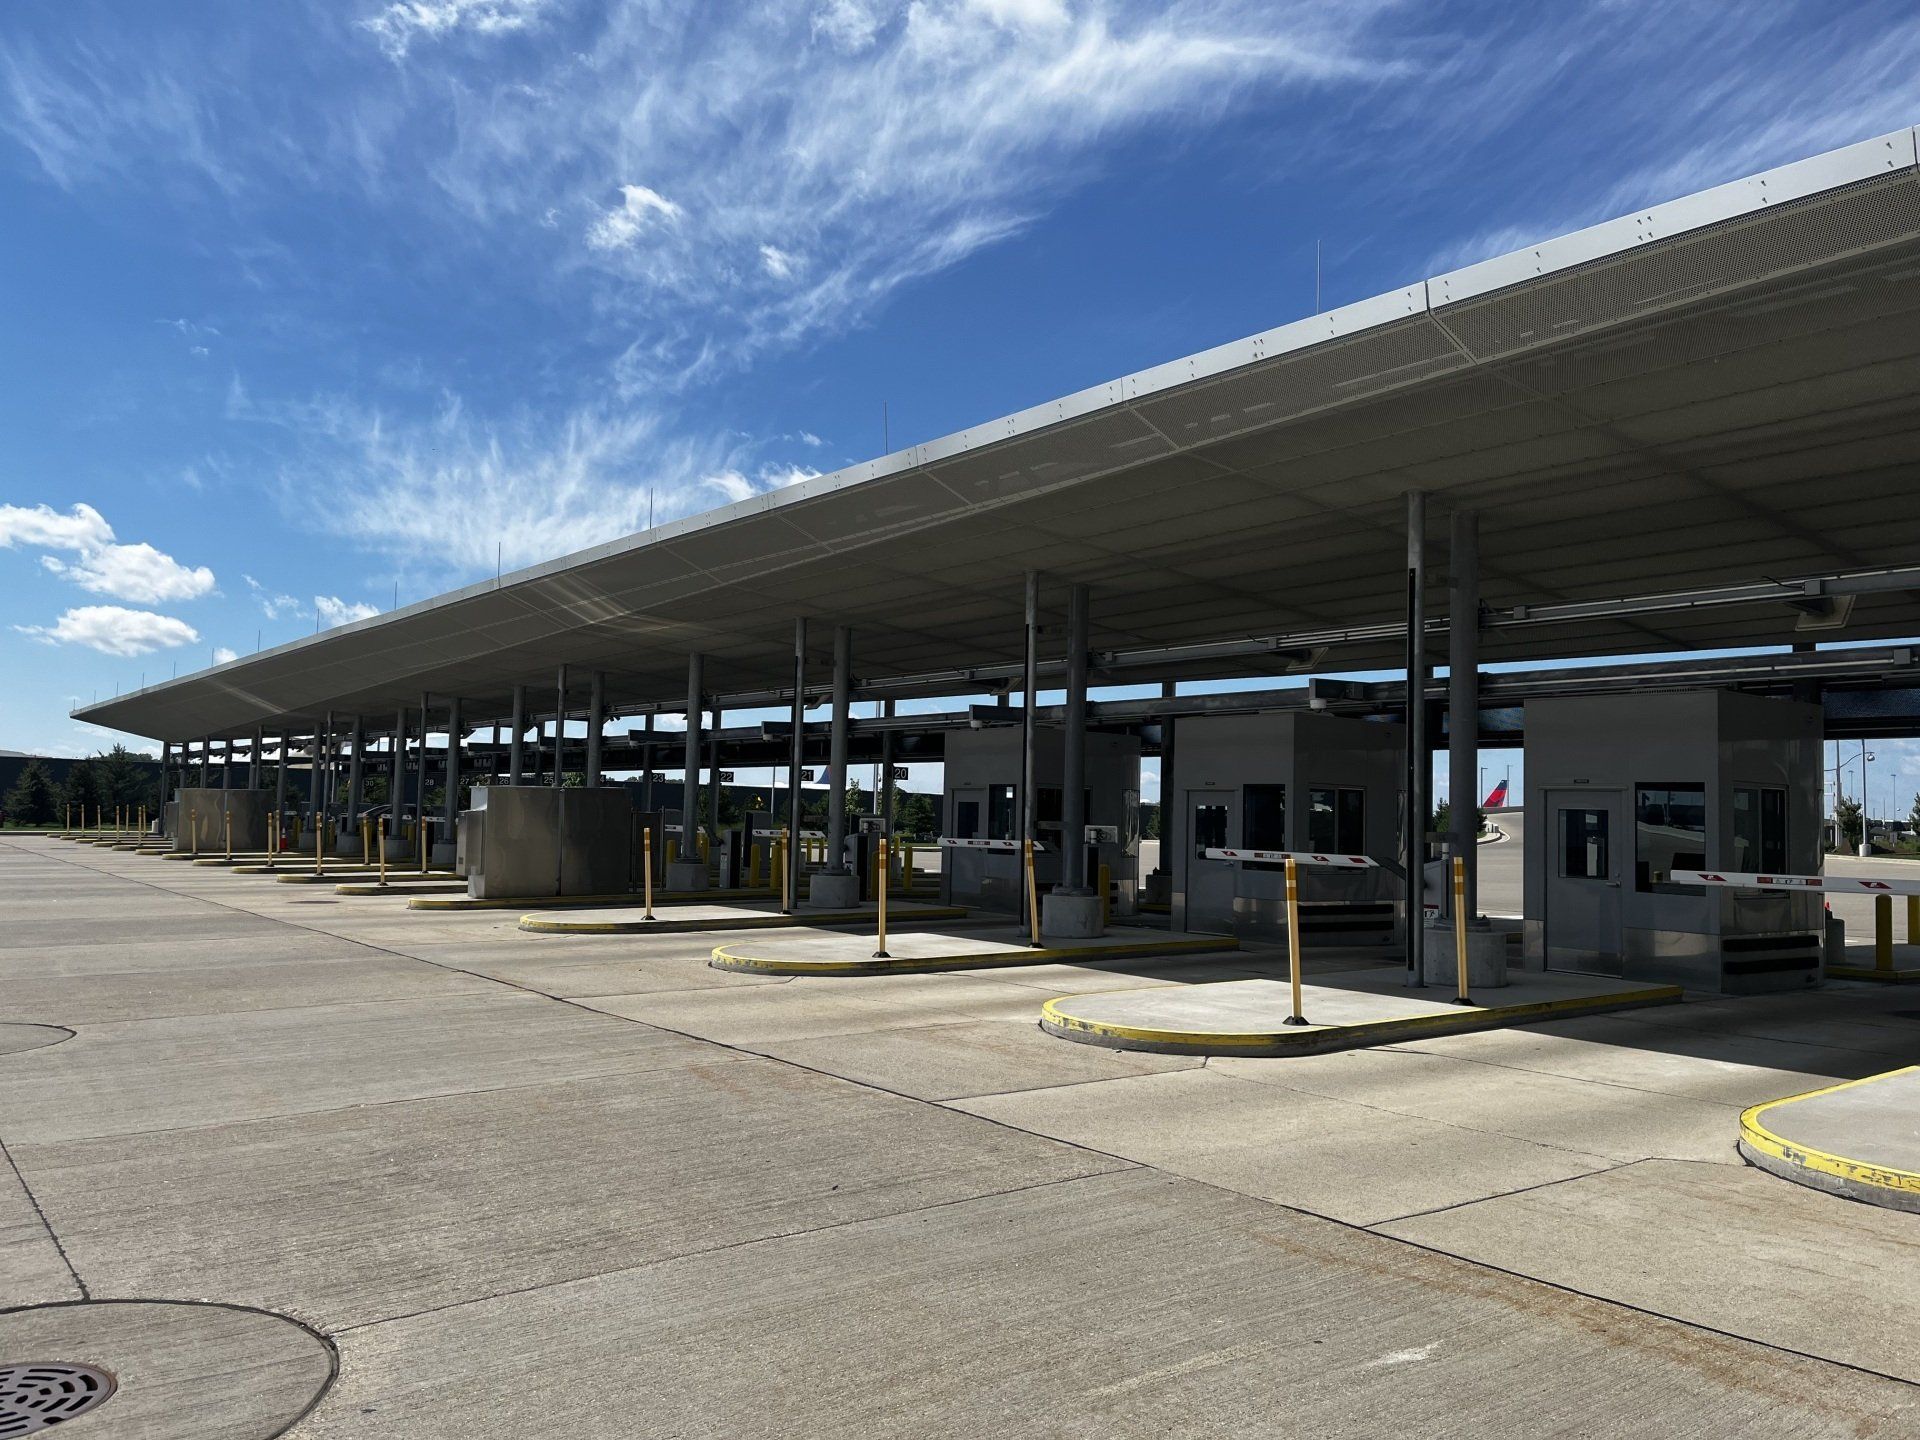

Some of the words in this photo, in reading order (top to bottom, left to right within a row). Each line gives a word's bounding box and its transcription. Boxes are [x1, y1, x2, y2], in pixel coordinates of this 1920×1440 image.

[652, 773, 664, 783] 23
[720, 772, 733, 782] 22
[801, 770, 812, 780] 21
[894, 768, 907, 779] 20
